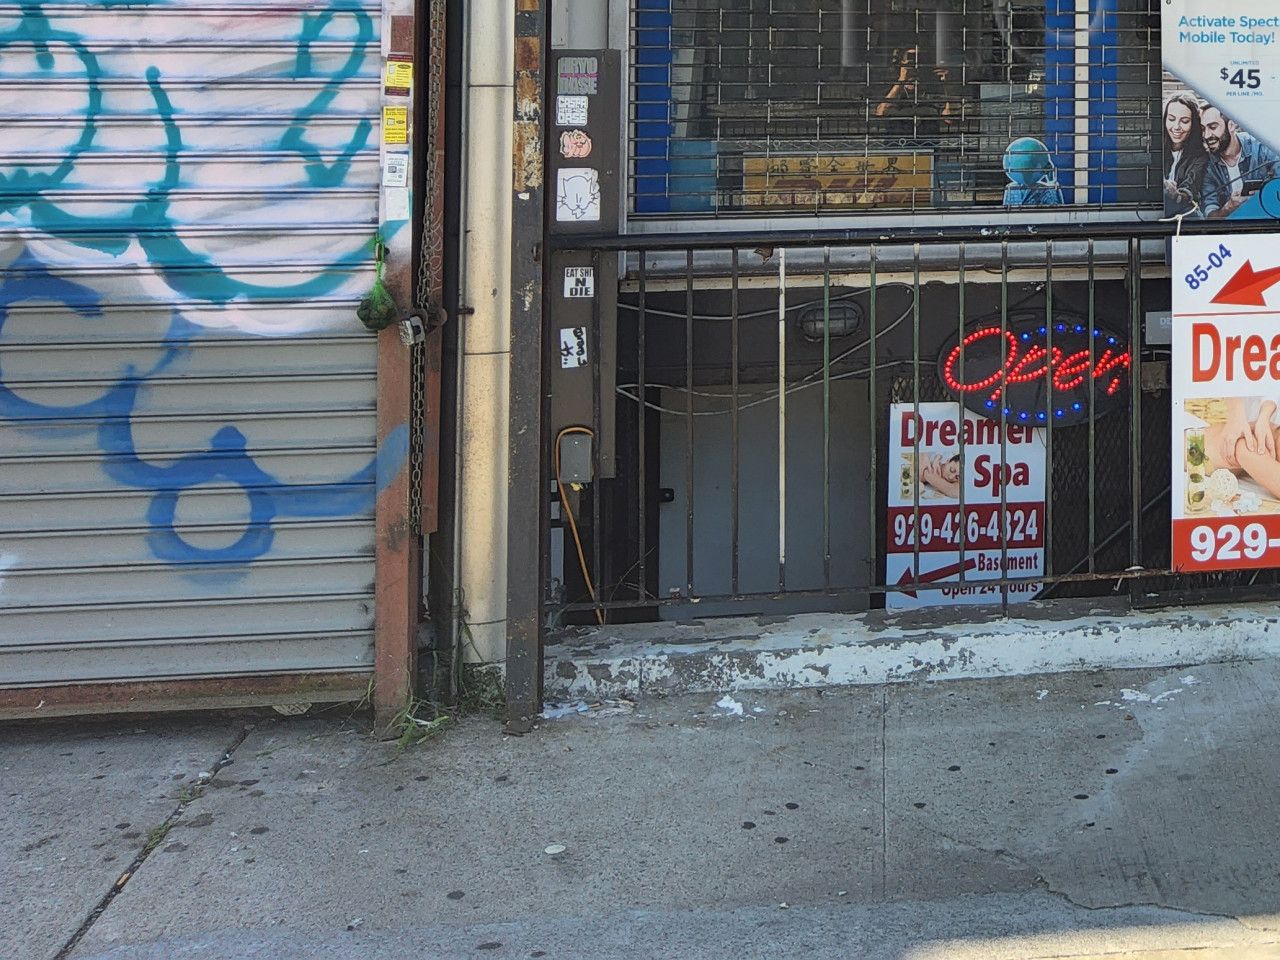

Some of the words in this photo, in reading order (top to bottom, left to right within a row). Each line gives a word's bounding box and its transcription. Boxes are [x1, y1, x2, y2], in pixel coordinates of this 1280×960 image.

[1178, 15, 1236, 28] Activate
[1179, 30, 1226, 44] Mobile
[1230, 31, 1275, 46] Today!
[1220, 67, 1261, 89] $45
[566, 268, 579, 278] EAT
[1184, 243, 1233, 291] 85-04
[575, 277, 587, 287] N
[944, 326, 1131, 400] Open
[900, 411, 1035, 448] Dreamer
[973, 454, 1031, 498] Spa
